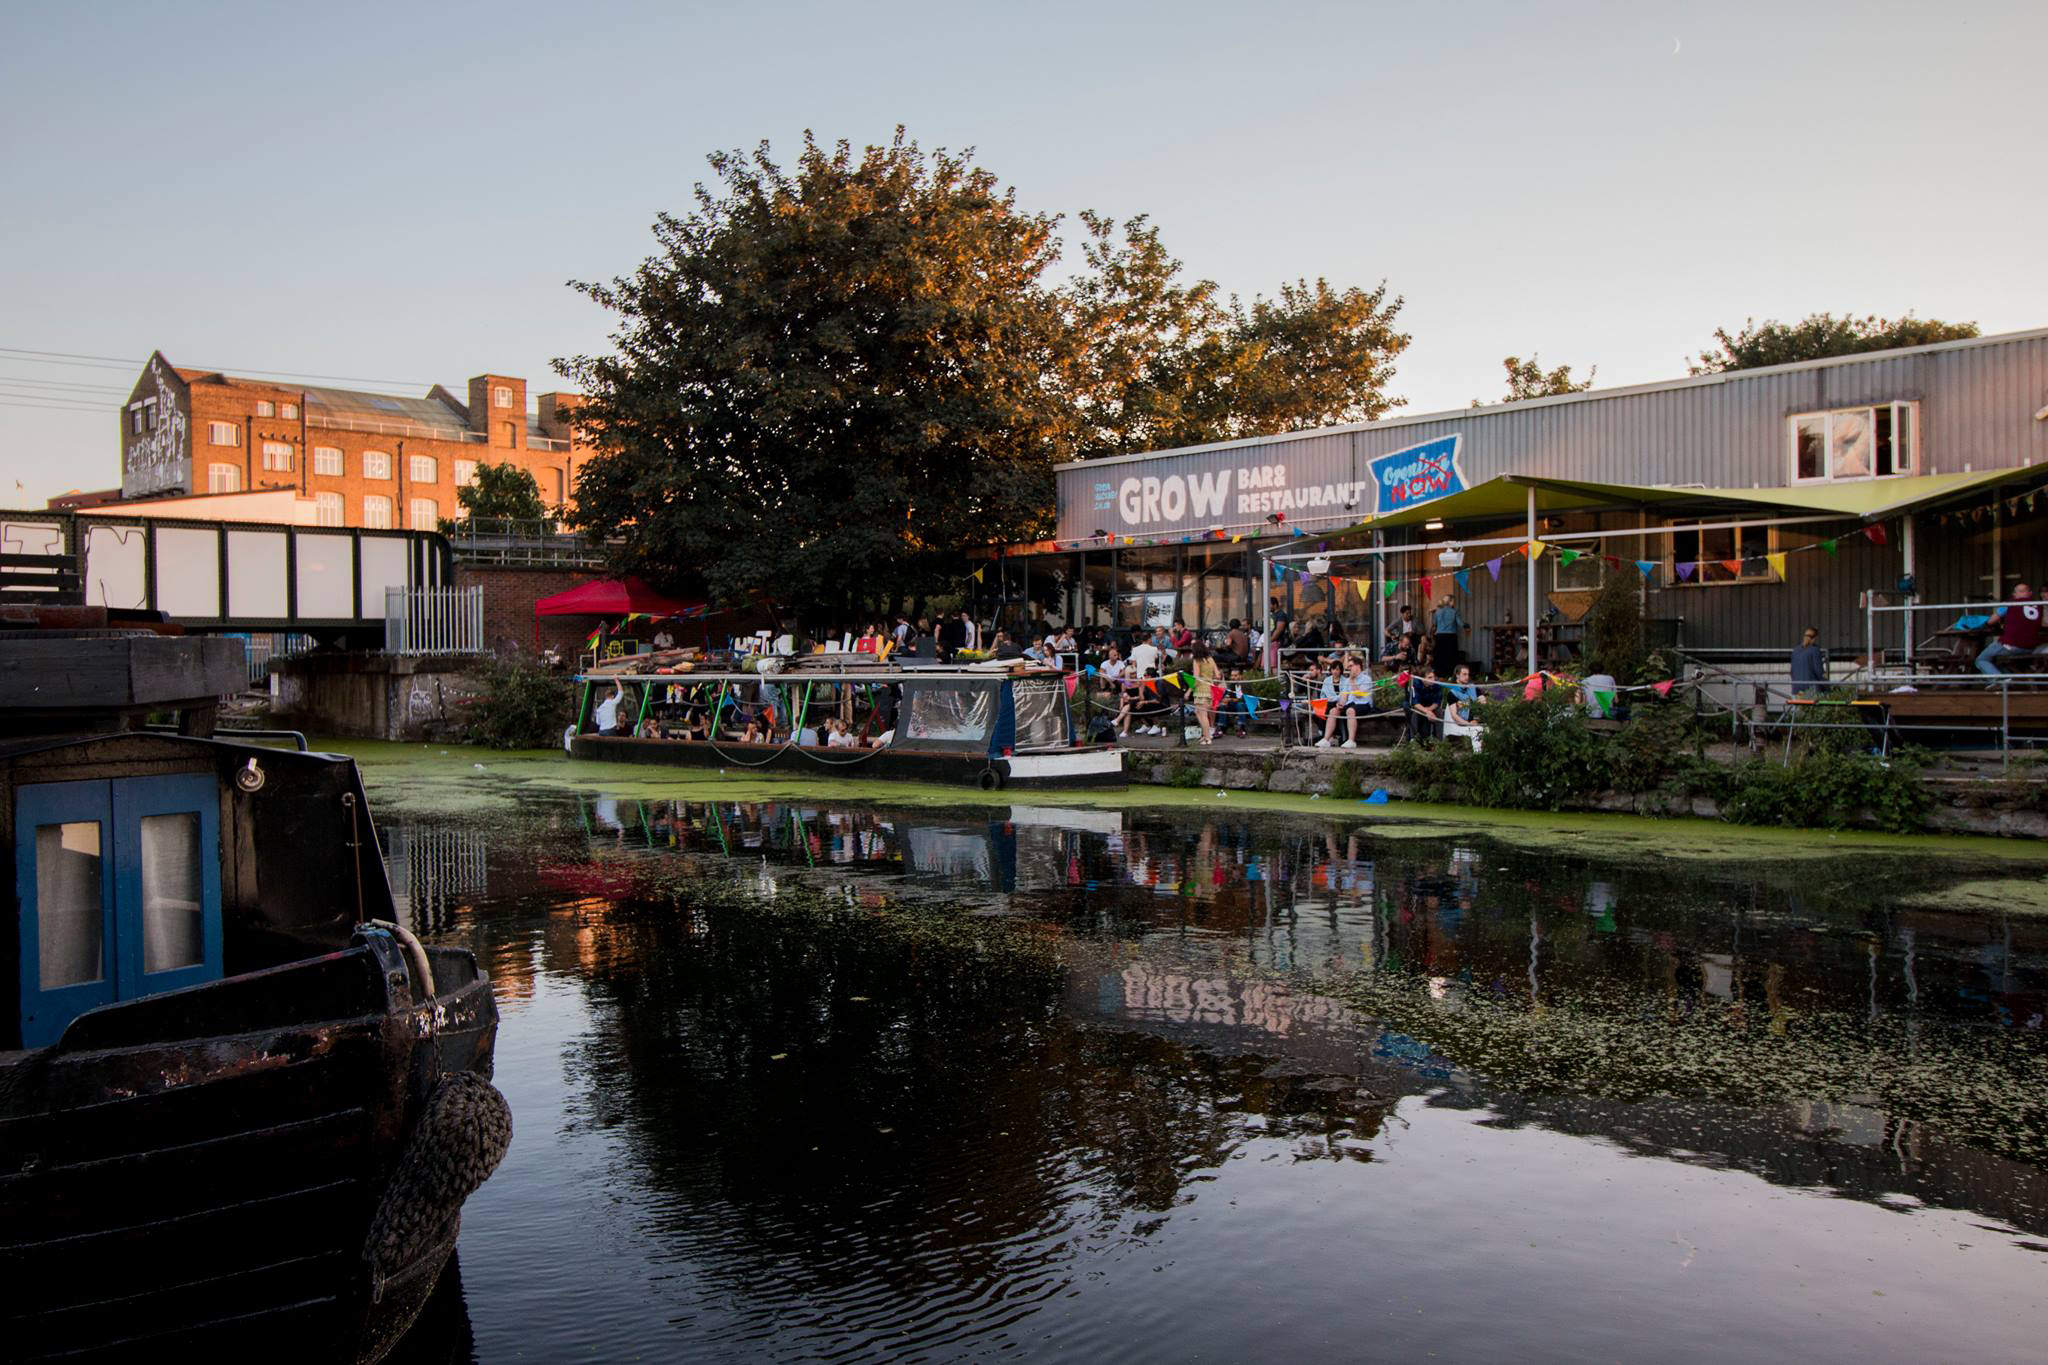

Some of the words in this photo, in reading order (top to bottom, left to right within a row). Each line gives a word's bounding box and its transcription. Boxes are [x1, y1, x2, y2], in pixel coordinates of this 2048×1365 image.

[1119, 469, 1232, 525] GROW
[1238, 481, 1366, 513] RESTAURANT
[1392, 471, 1453, 503] NOW
